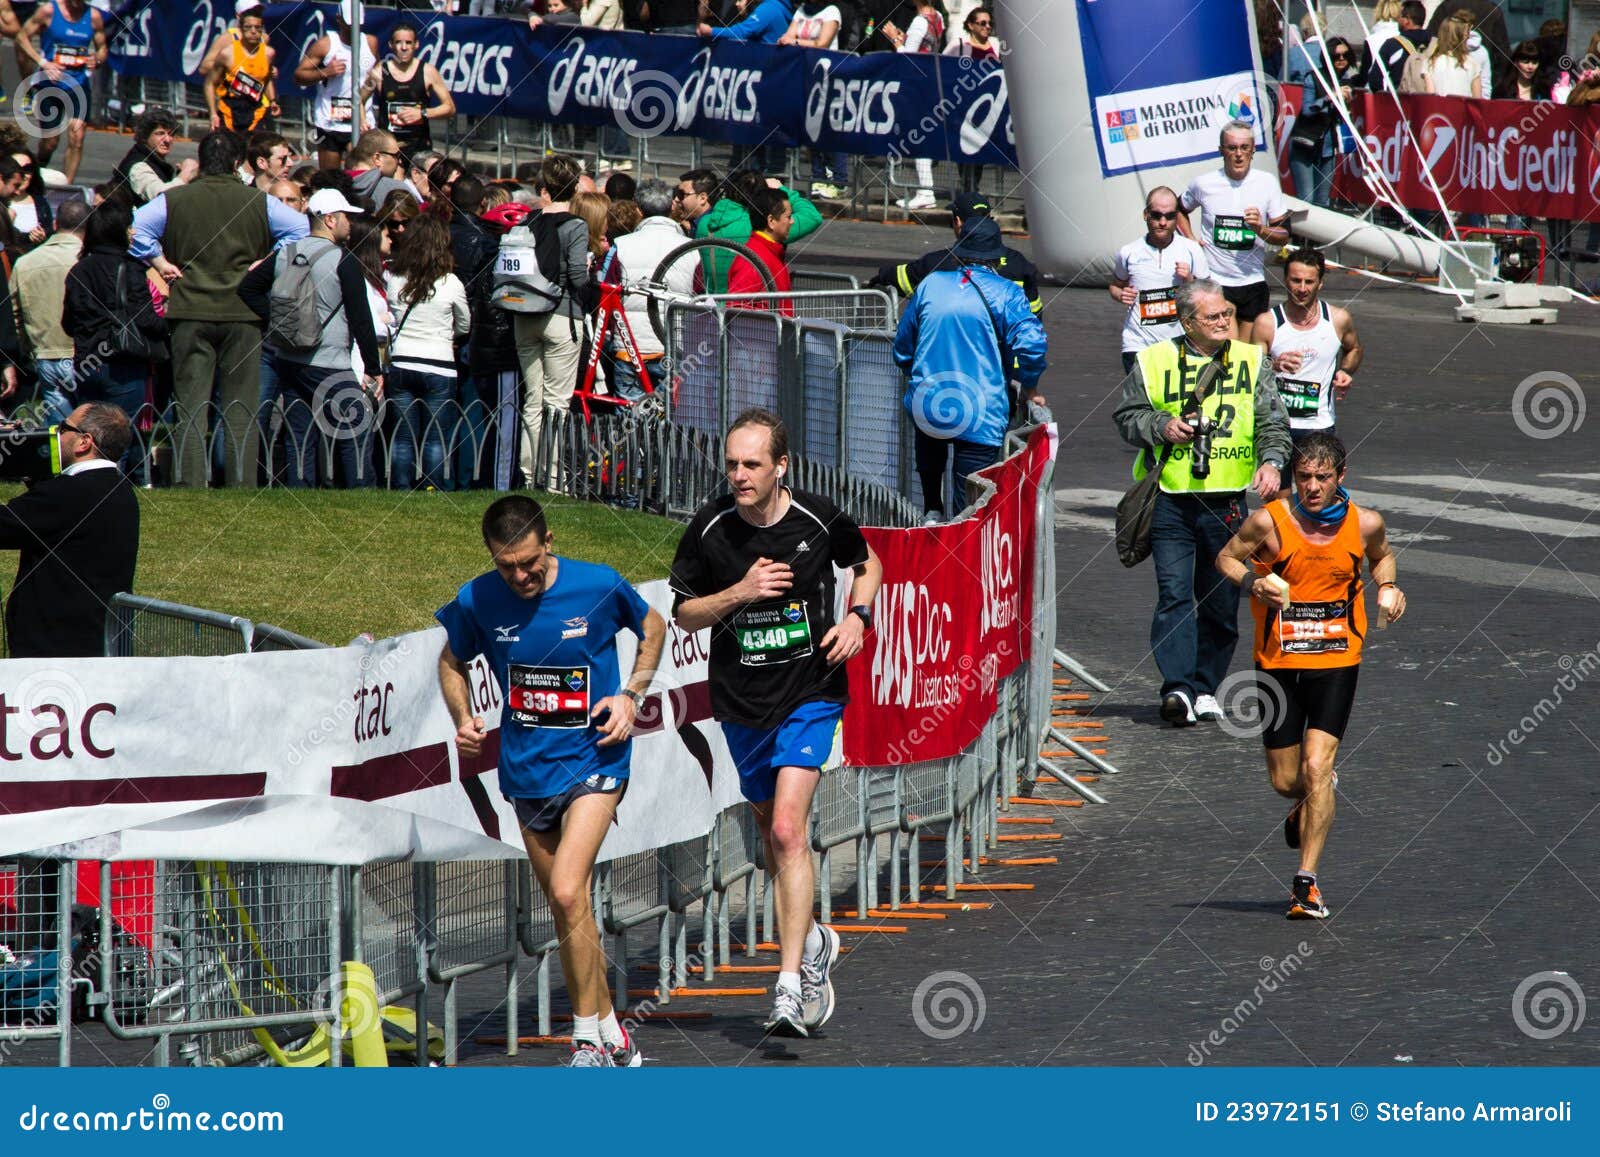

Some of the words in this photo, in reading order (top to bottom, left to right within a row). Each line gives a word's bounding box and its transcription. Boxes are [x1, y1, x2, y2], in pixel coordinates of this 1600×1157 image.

[1140, 94, 1226, 121] MARATONA
[1144, 122, 1160, 139] di
[1164, 114, 1210, 137] ROMA
[1459, 125, 1577, 195] UniCredit
[1167, 445, 1251, 460] OTGRAFO
[916, 584, 952, 665] Doc
[743, 628, 788, 649] 4340
[522, 691, 560, 712] 336
